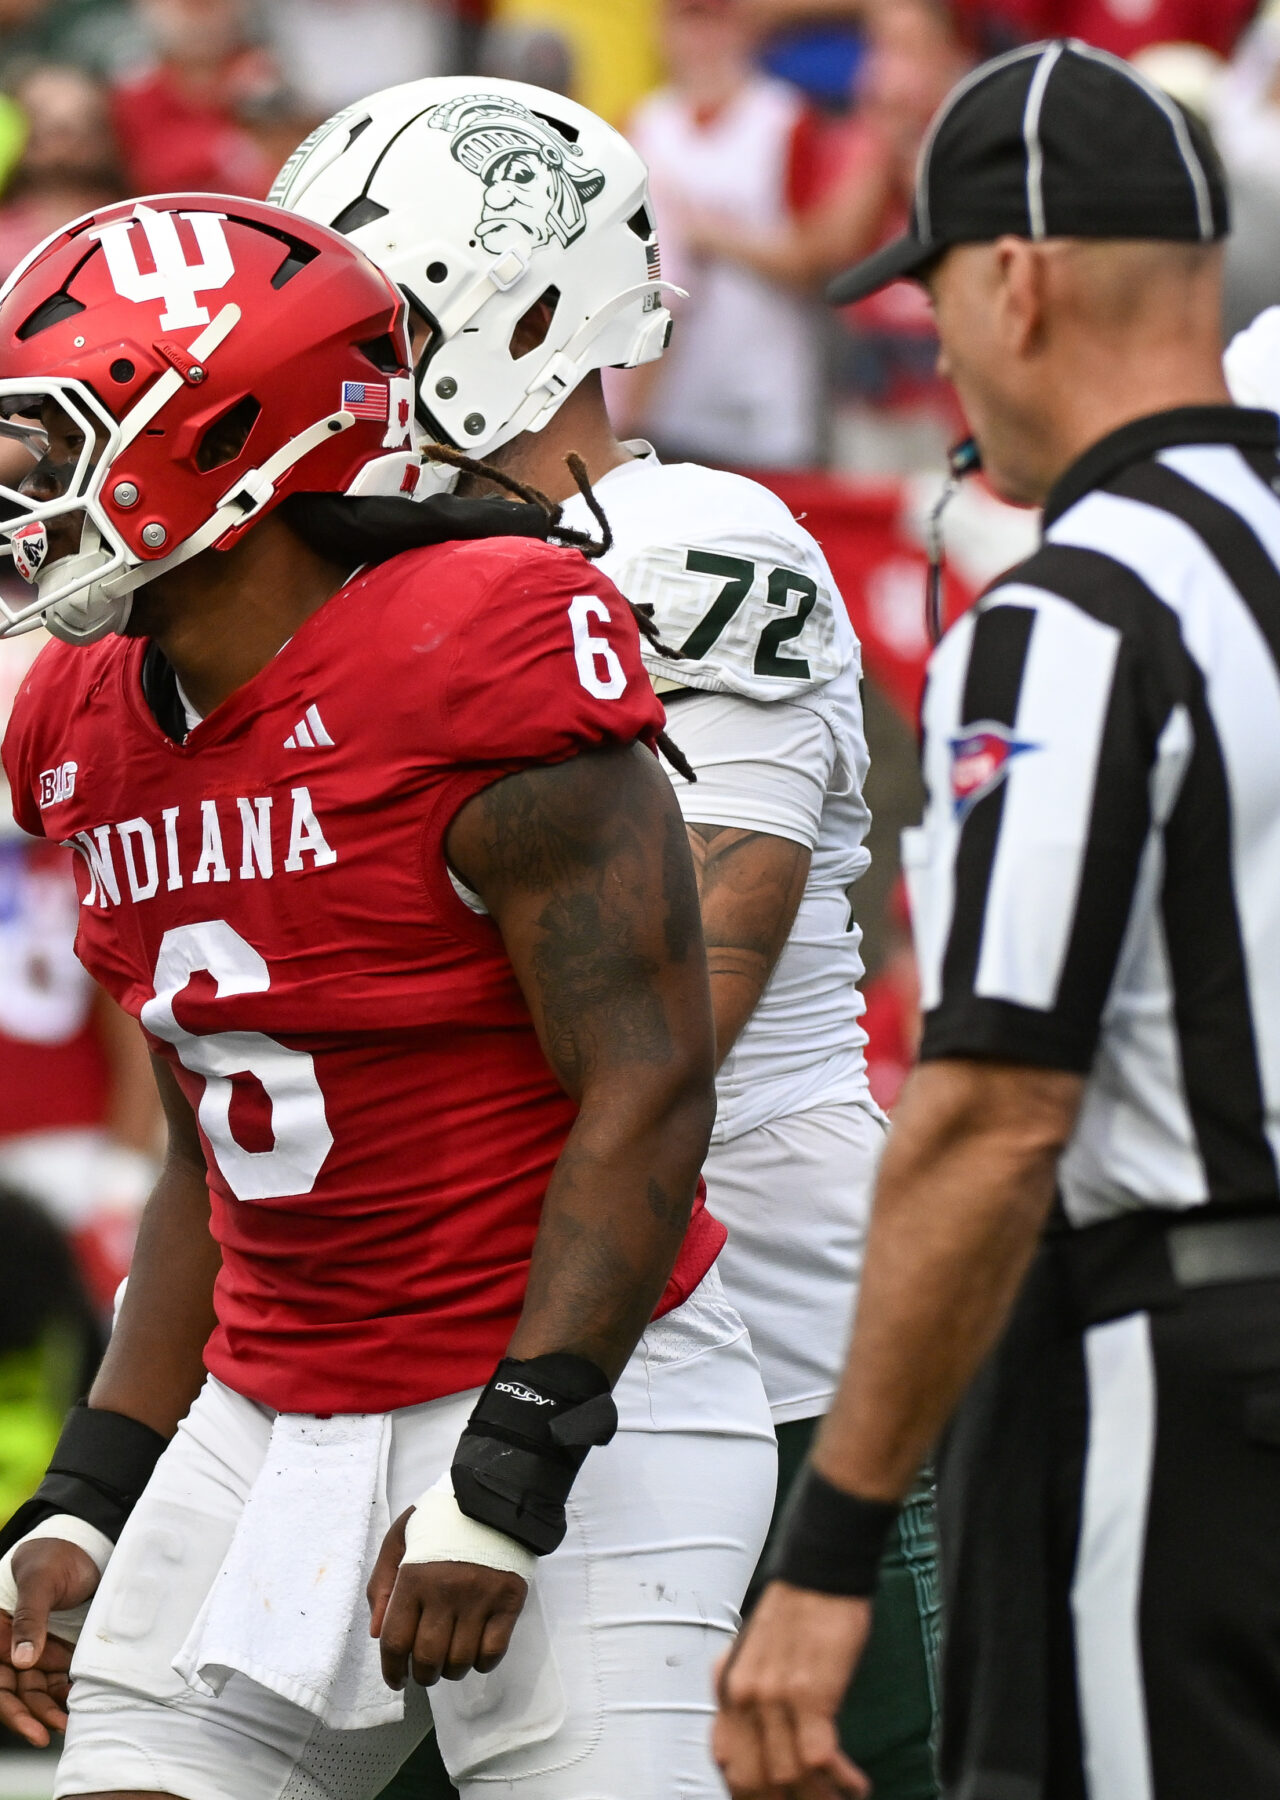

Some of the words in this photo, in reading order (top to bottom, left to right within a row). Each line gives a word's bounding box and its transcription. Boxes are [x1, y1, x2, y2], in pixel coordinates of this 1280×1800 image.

[568, 595, 627, 700] 6
[682, 549, 818, 682] 72
[140, 919, 335, 1201] 6
